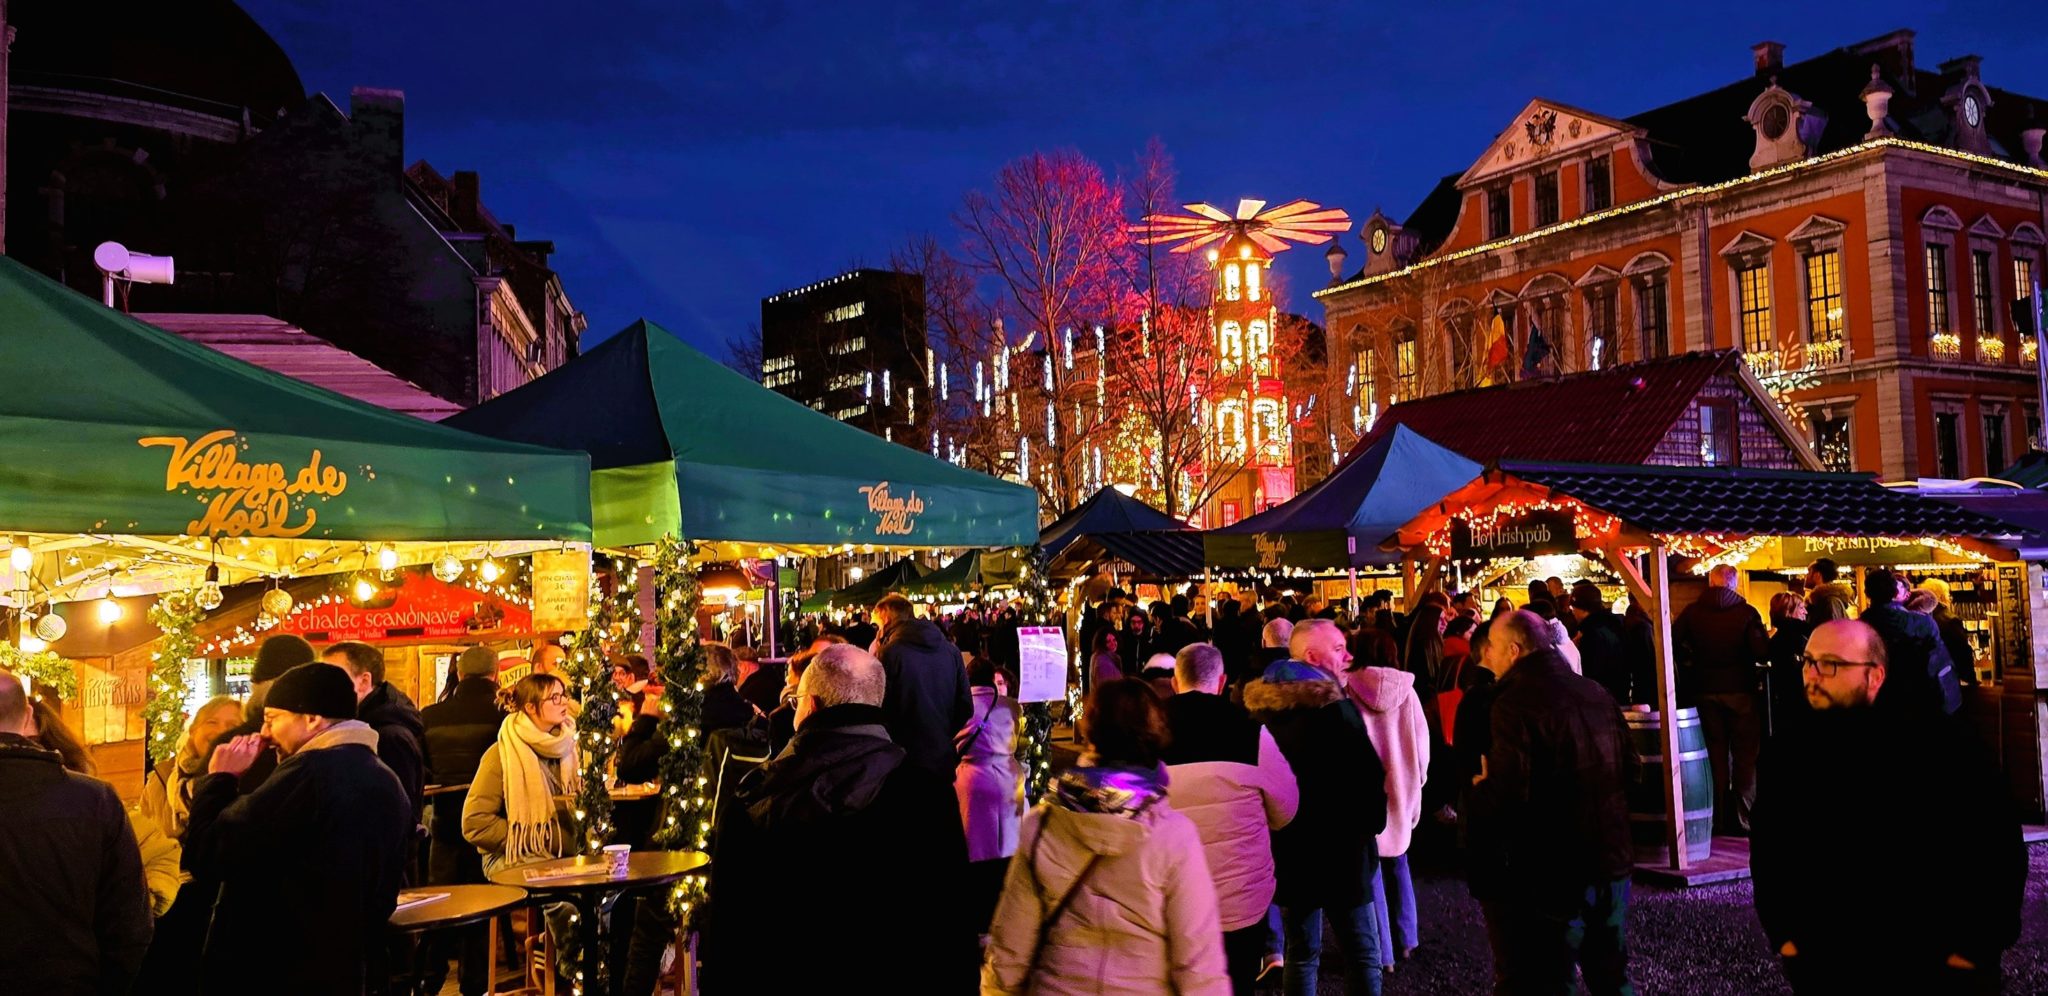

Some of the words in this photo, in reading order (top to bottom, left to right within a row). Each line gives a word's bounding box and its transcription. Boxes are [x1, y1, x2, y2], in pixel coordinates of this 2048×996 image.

[138, 430, 288, 508] Village
[286, 449, 347, 496] de
[187, 489, 316, 538] Noël
[858, 481, 905, 520] Village
[905, 489, 924, 513] de
[876, 511, 914, 535] Noël
[1470, 525, 1494, 550] Hot
[1497, 525, 1524, 546] Irish
[1526, 524, 1551, 549] pub
[299, 606, 361, 631] chalet
